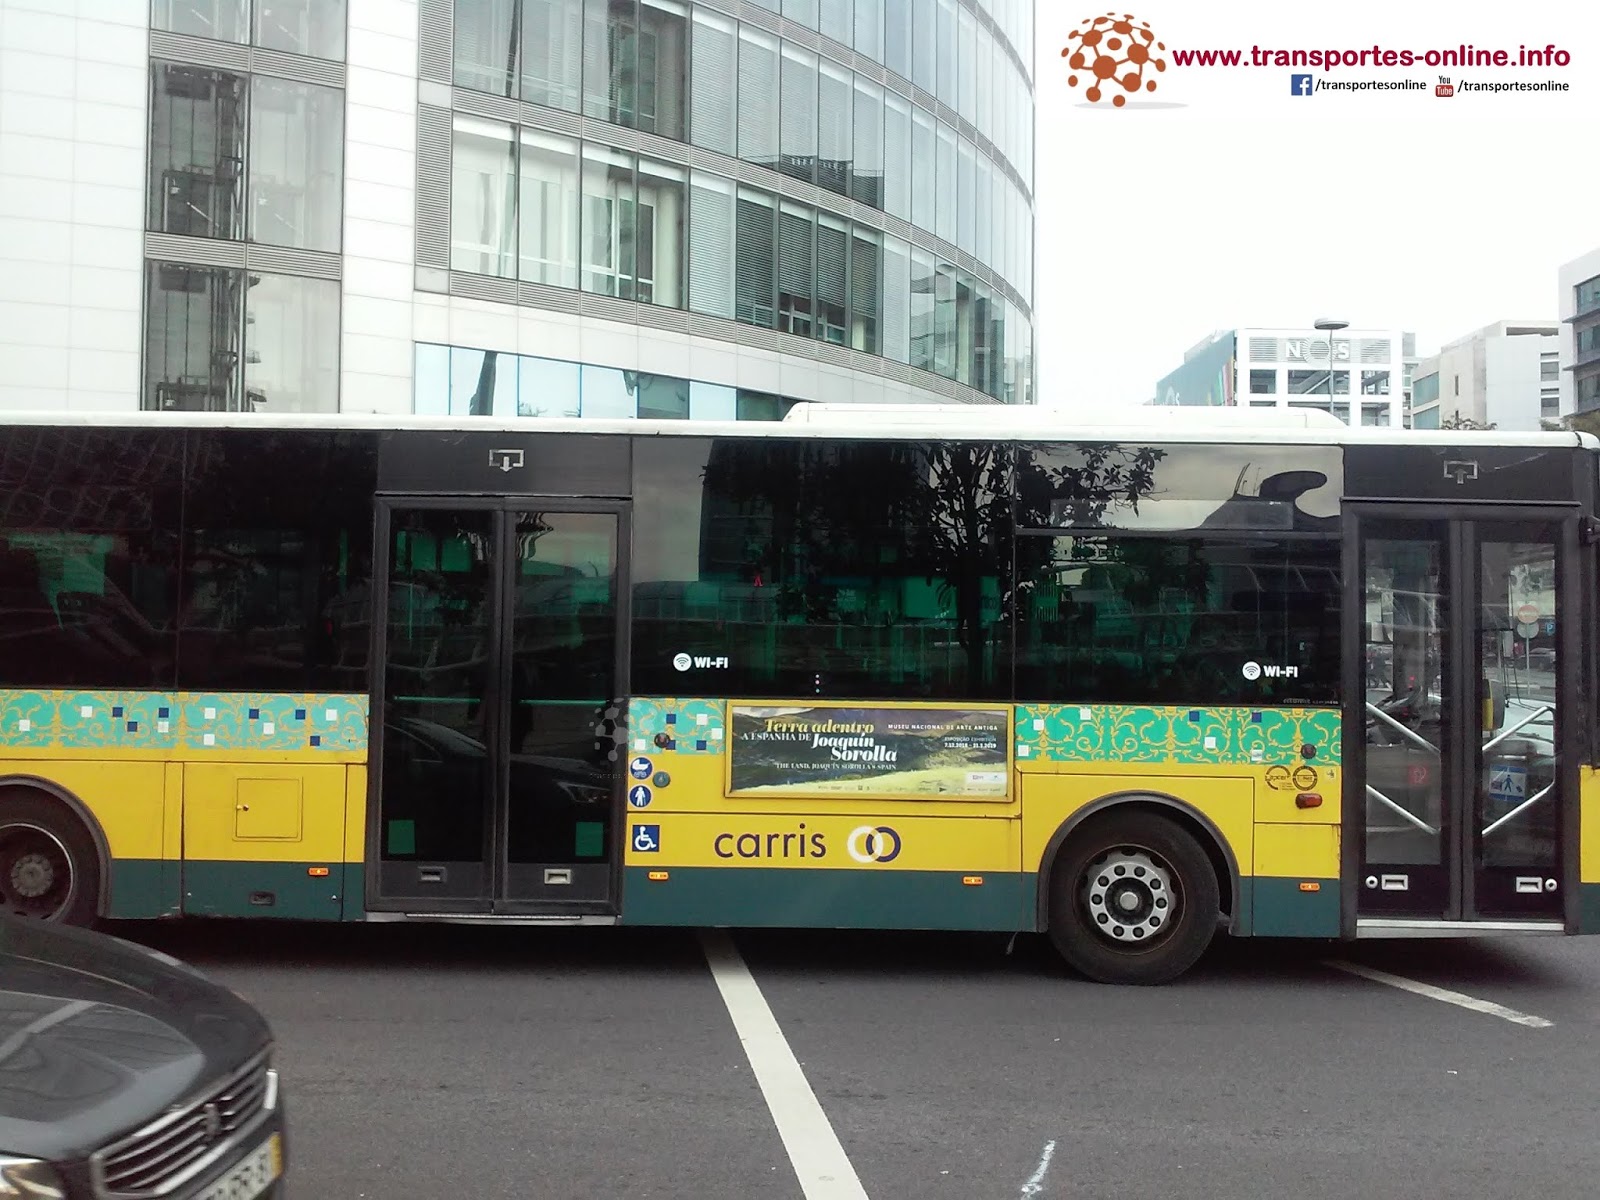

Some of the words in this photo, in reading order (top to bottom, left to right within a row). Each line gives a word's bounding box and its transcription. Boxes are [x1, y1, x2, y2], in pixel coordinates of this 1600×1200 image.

[1285, 338, 1350, 365] NOS
[694, 656, 729, 669] WI-FI
[1263, 664, 1299, 678] WI-FI
[764, 719, 808, 733] Terra
[811, 719, 875, 734] adentro
[751, 732, 797, 741] ESPANHA
[798, 733, 811, 741] DE
[811, 732, 875, 750] Joaquín
[830, 745, 897, 762] Sorolla
[714, 822, 827, 858] carris
